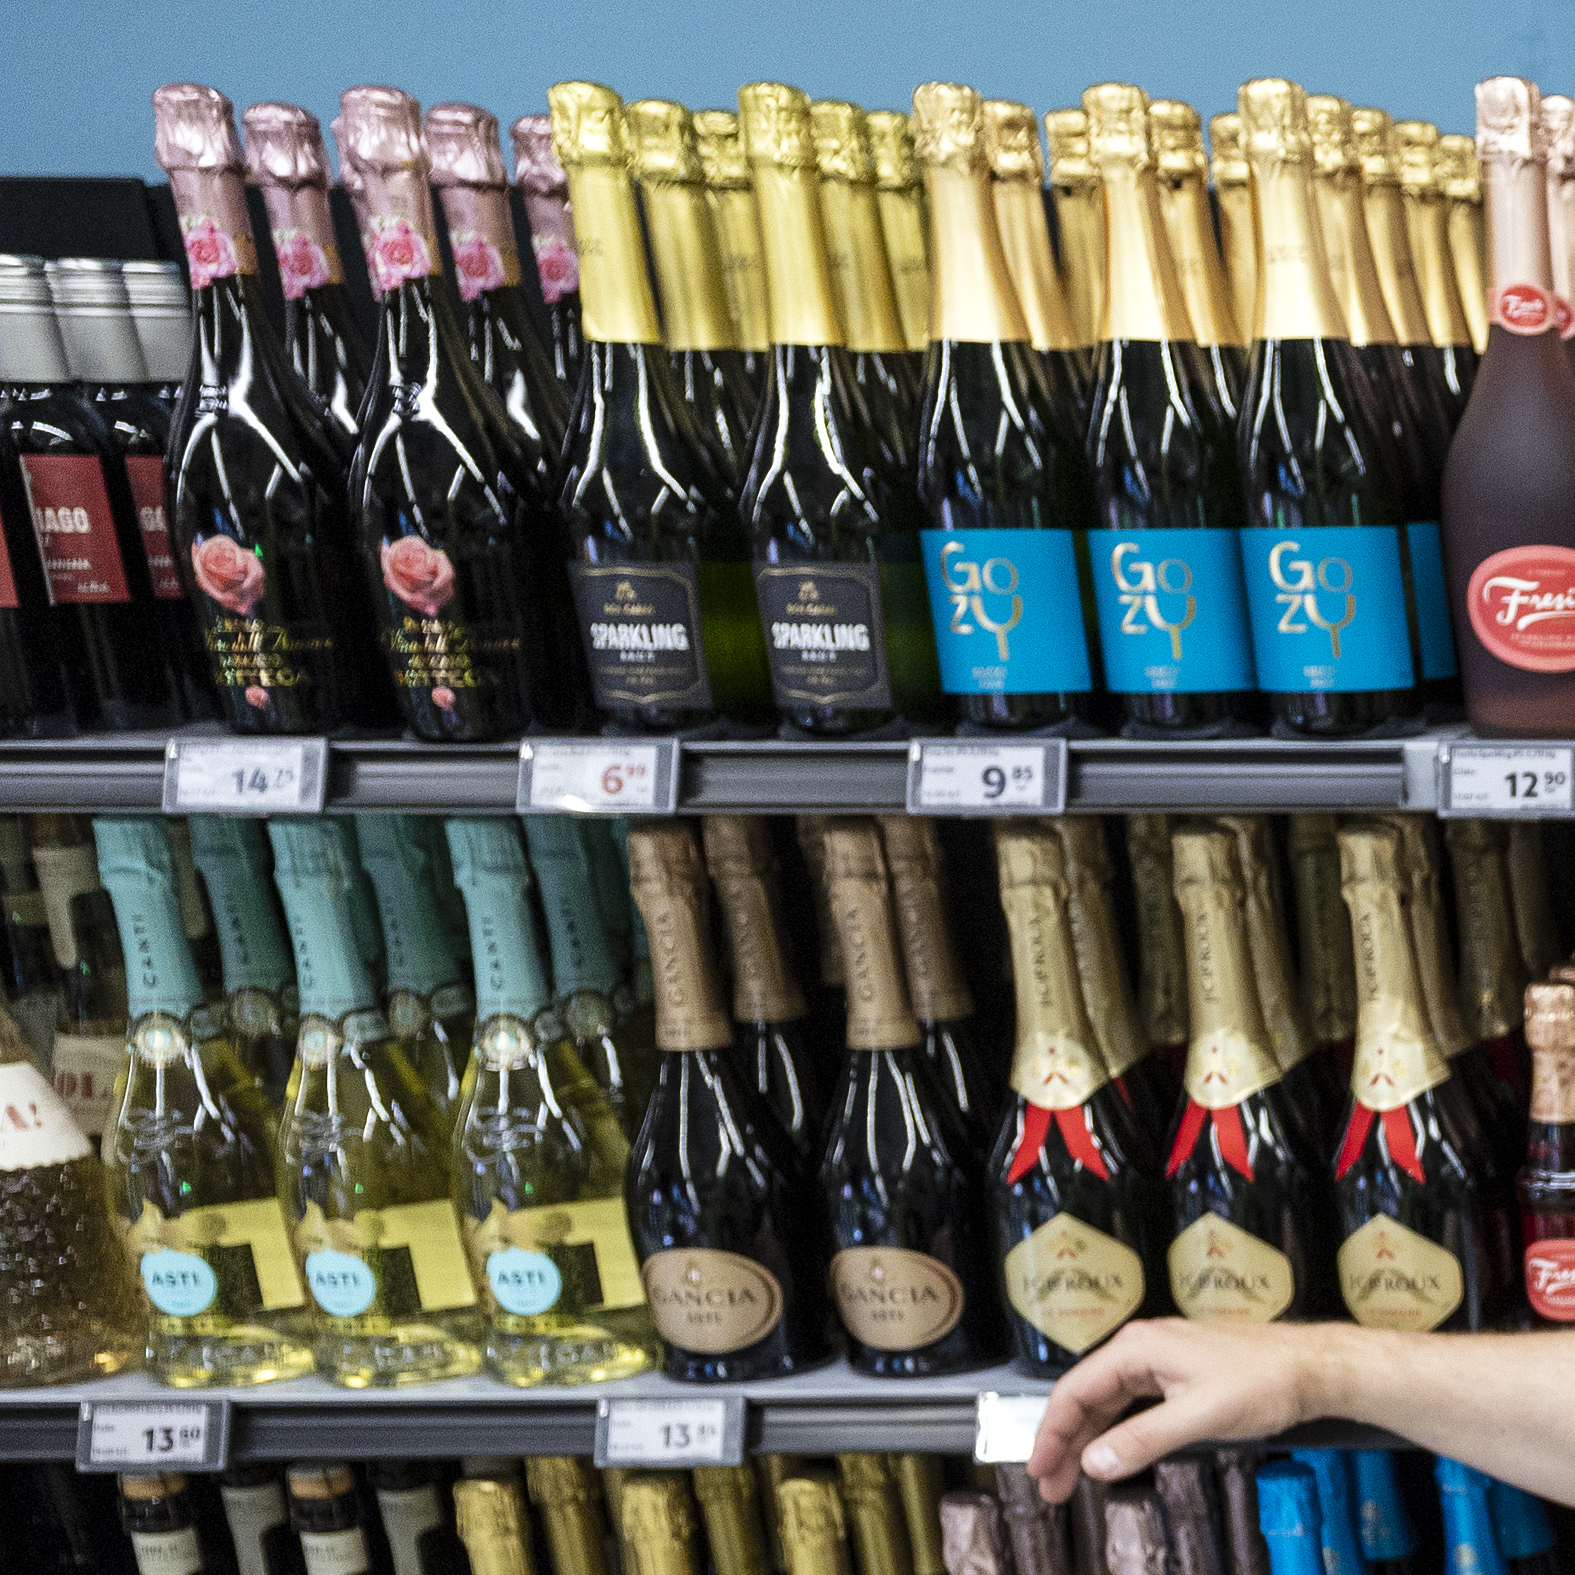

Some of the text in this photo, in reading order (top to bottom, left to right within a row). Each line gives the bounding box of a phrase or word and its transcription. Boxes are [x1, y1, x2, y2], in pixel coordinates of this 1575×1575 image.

[590, 622, 689, 651] SPARKLING
[772, 622, 869, 651] SPARKLING
[600, 765, 623, 793] 6
[981, 766, 1006, 798] 9
[1504, 772, 1538, 798] 12
[152, 1270, 202, 1289] ASTI
[316, 1270, 362, 1289] ASTI
[494, 1269, 546, 1288] ASTI
[143, 1427, 174, 1452] 13
[661, 1423, 691, 1448] 13
